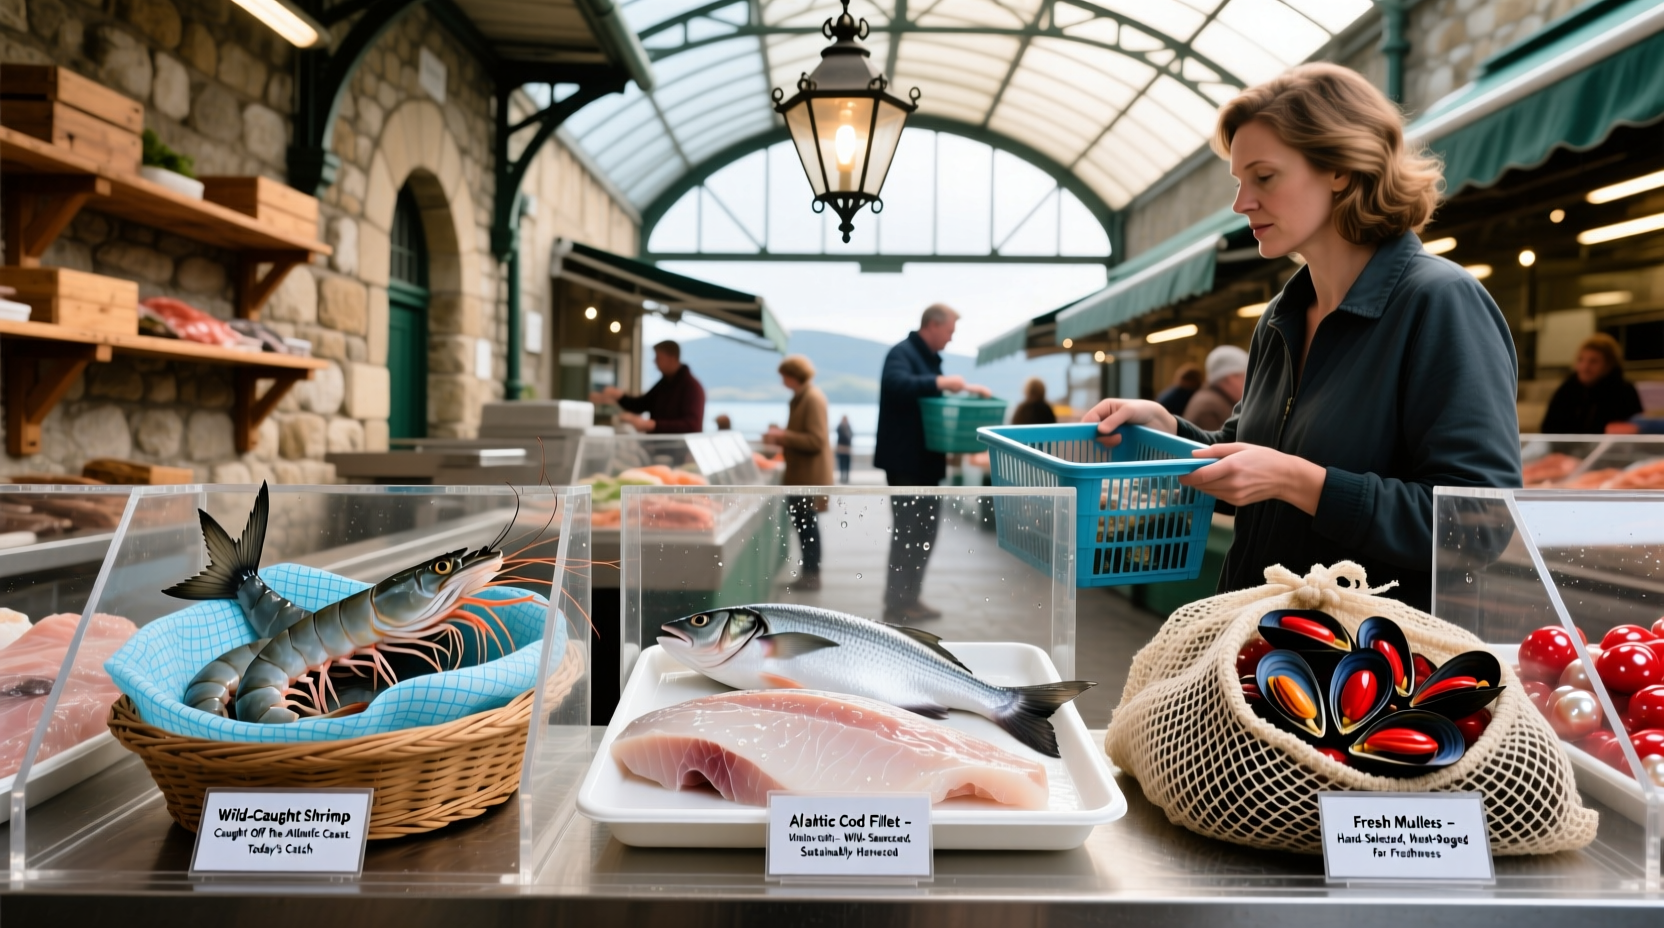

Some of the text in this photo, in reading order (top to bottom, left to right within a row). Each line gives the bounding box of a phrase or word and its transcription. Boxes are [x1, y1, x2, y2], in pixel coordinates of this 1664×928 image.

[219, 808, 351, 825] Wild-Caught Shrimp
[839, 814, 865, 828] Cod
[1353, 815, 1391, 829] Fresh
